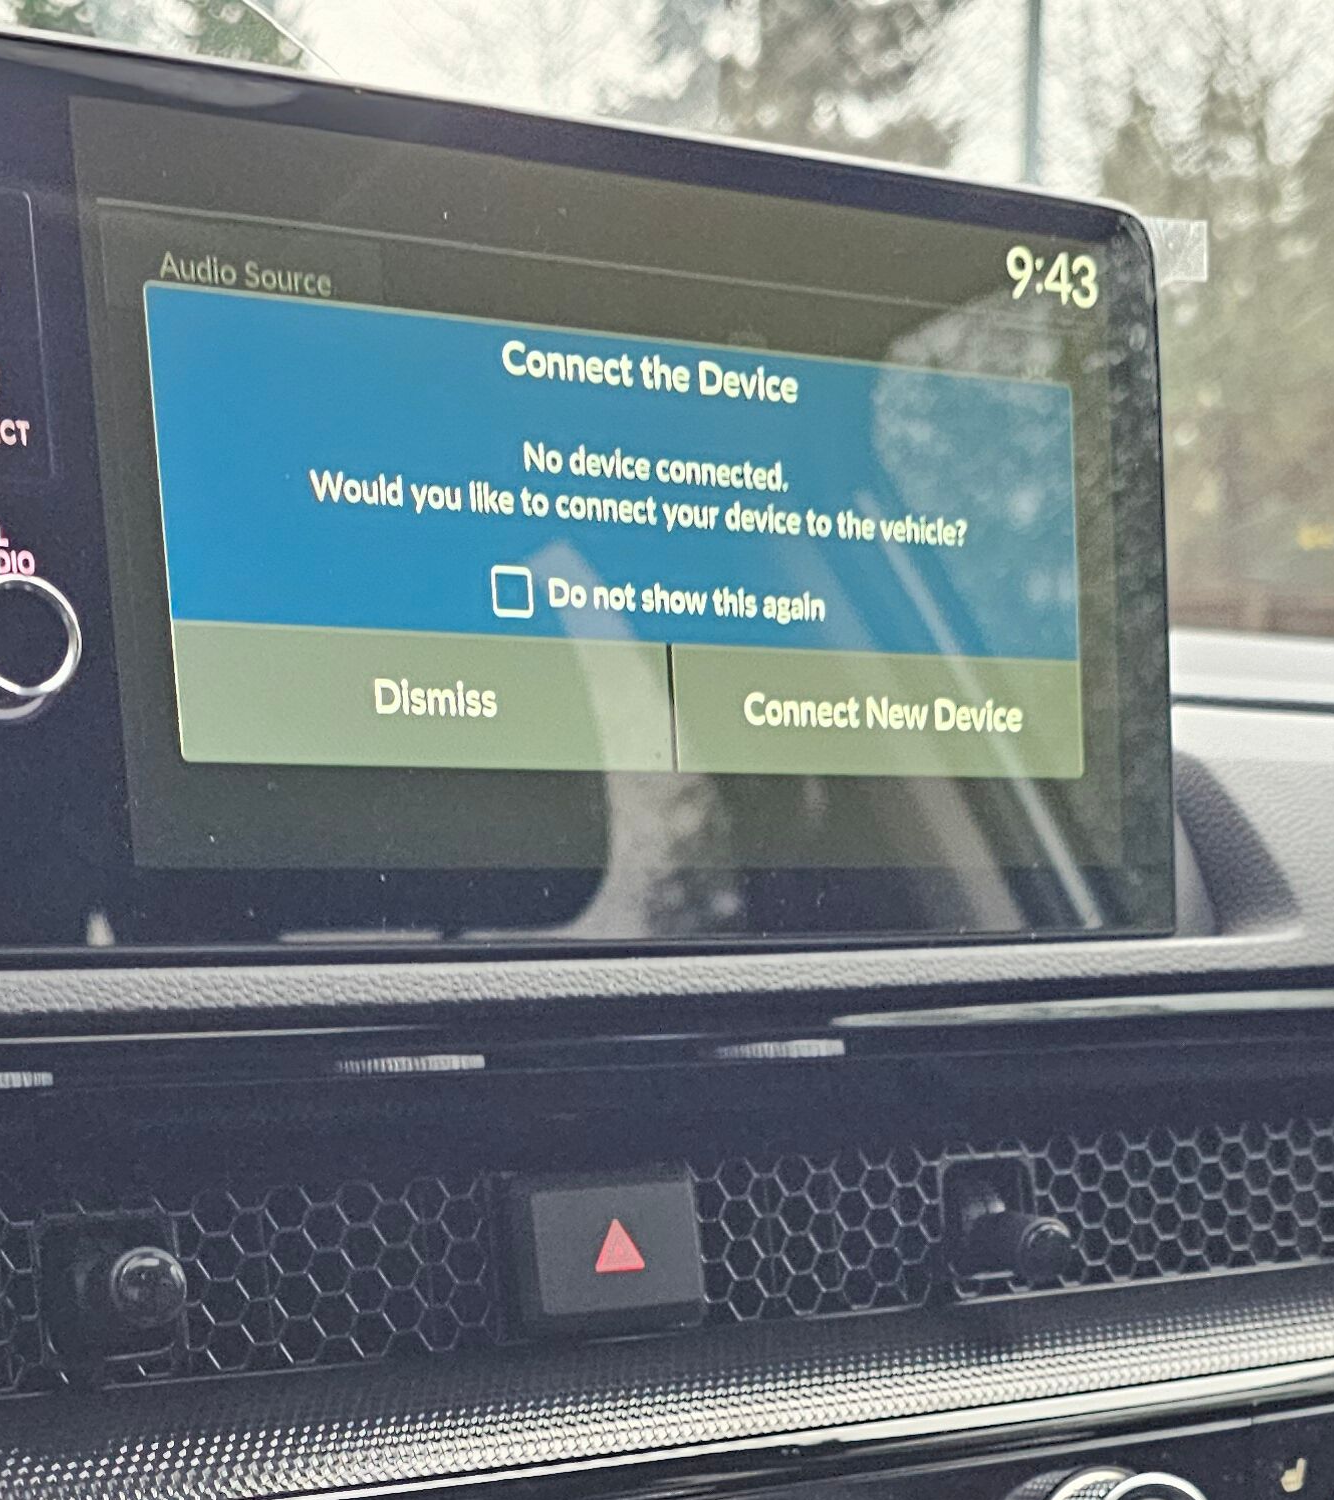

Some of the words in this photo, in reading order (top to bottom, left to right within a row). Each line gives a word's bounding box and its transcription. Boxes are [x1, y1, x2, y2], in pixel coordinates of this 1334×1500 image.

[161, 251, 237, 288] Audio
[245, 254, 332, 296] Source
[1006, 246, 1098, 309] 9:43
[501, 340, 633, 388] Connect
[640, 355, 690, 394] the
[698, 360, 799, 404] Device
[523, 441, 563, 474] No
[570, 443, 650, 482] device
[656, 458, 789, 493] connected.
[310, 469, 404, 507] Would
[410, 482, 462, 514] you
[469, 481, 514, 516] like
[520, 486, 549, 518] to
[555, 493, 658, 526] connect
[662, 501, 720, 532] your
[725, 501, 801, 537] device
[806, 508, 833, 539] to
[837, 510, 875, 541] the
[880, 513, 967, 547] vehicle?
[548, 577, 587, 609] Do
[593, 585, 637, 614] not
[641, 583, 706, 616] show
[711, 587, 758, 620] this
[762, 591, 826, 625] again
[373, 678, 498, 719] Dismiss
[743, 691, 859, 731] Connect
[866, 696, 928, 732] New
[934, 698, 1023, 734] Device
